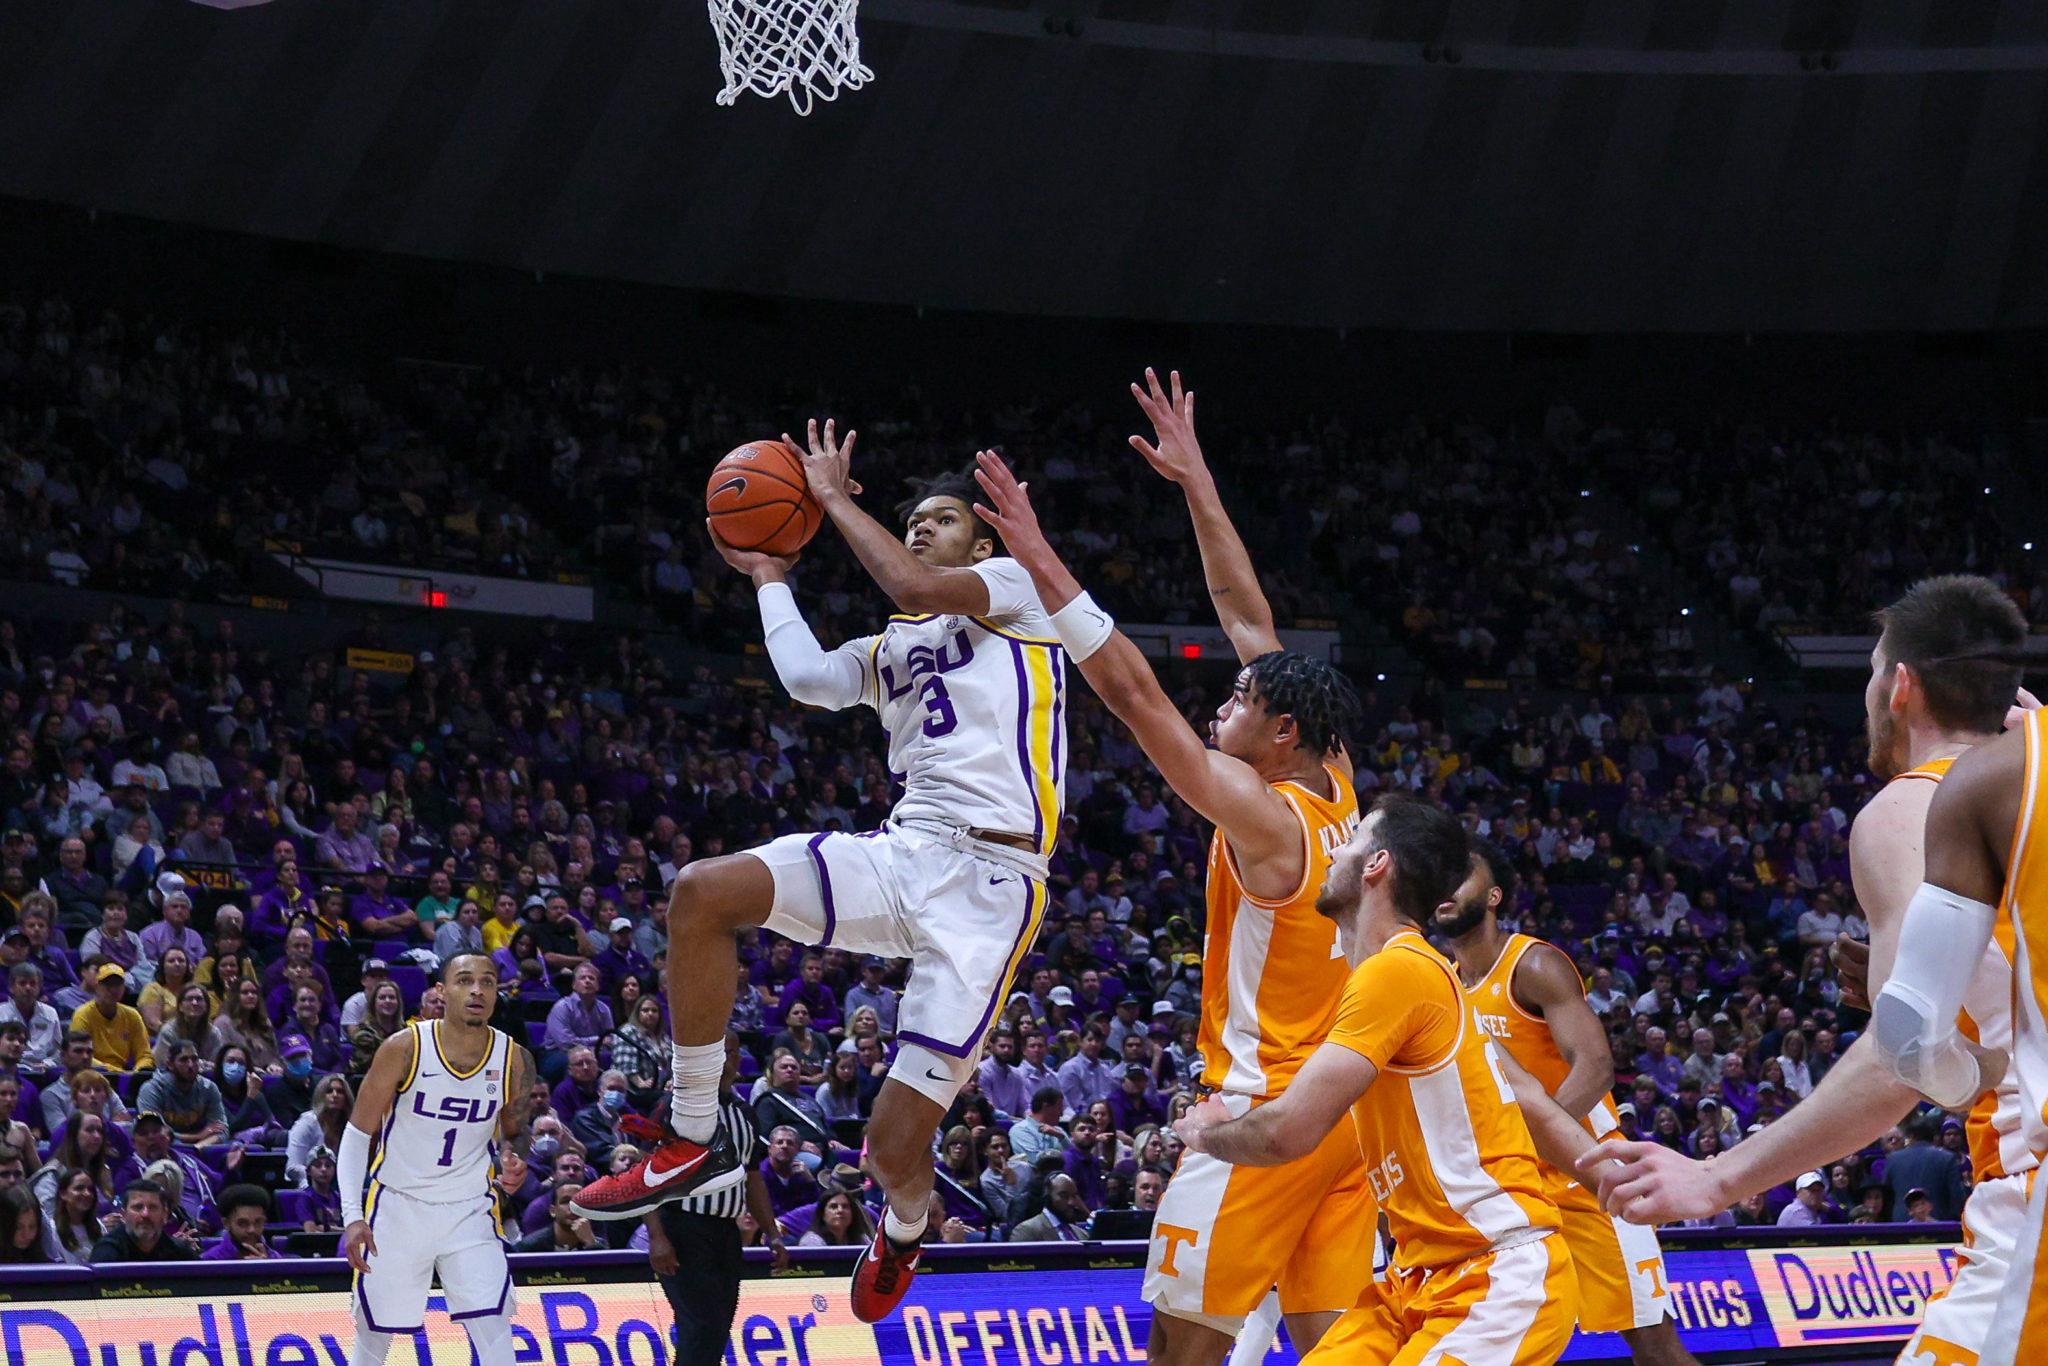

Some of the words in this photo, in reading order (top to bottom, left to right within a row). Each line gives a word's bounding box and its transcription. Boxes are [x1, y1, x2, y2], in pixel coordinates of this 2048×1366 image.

[880, 628, 975, 702] LSU
[918, 675, 958, 738] 3
[413, 1091, 497, 1123] LSU
[437, 1128, 457, 1166] 1
[1155, 1222, 1198, 1278] T
[1635, 1257, 1666, 1299] T
[1774, 1250, 1932, 1322] Dudley
[902, 1304, 1148, 1366] OFFICIAL
